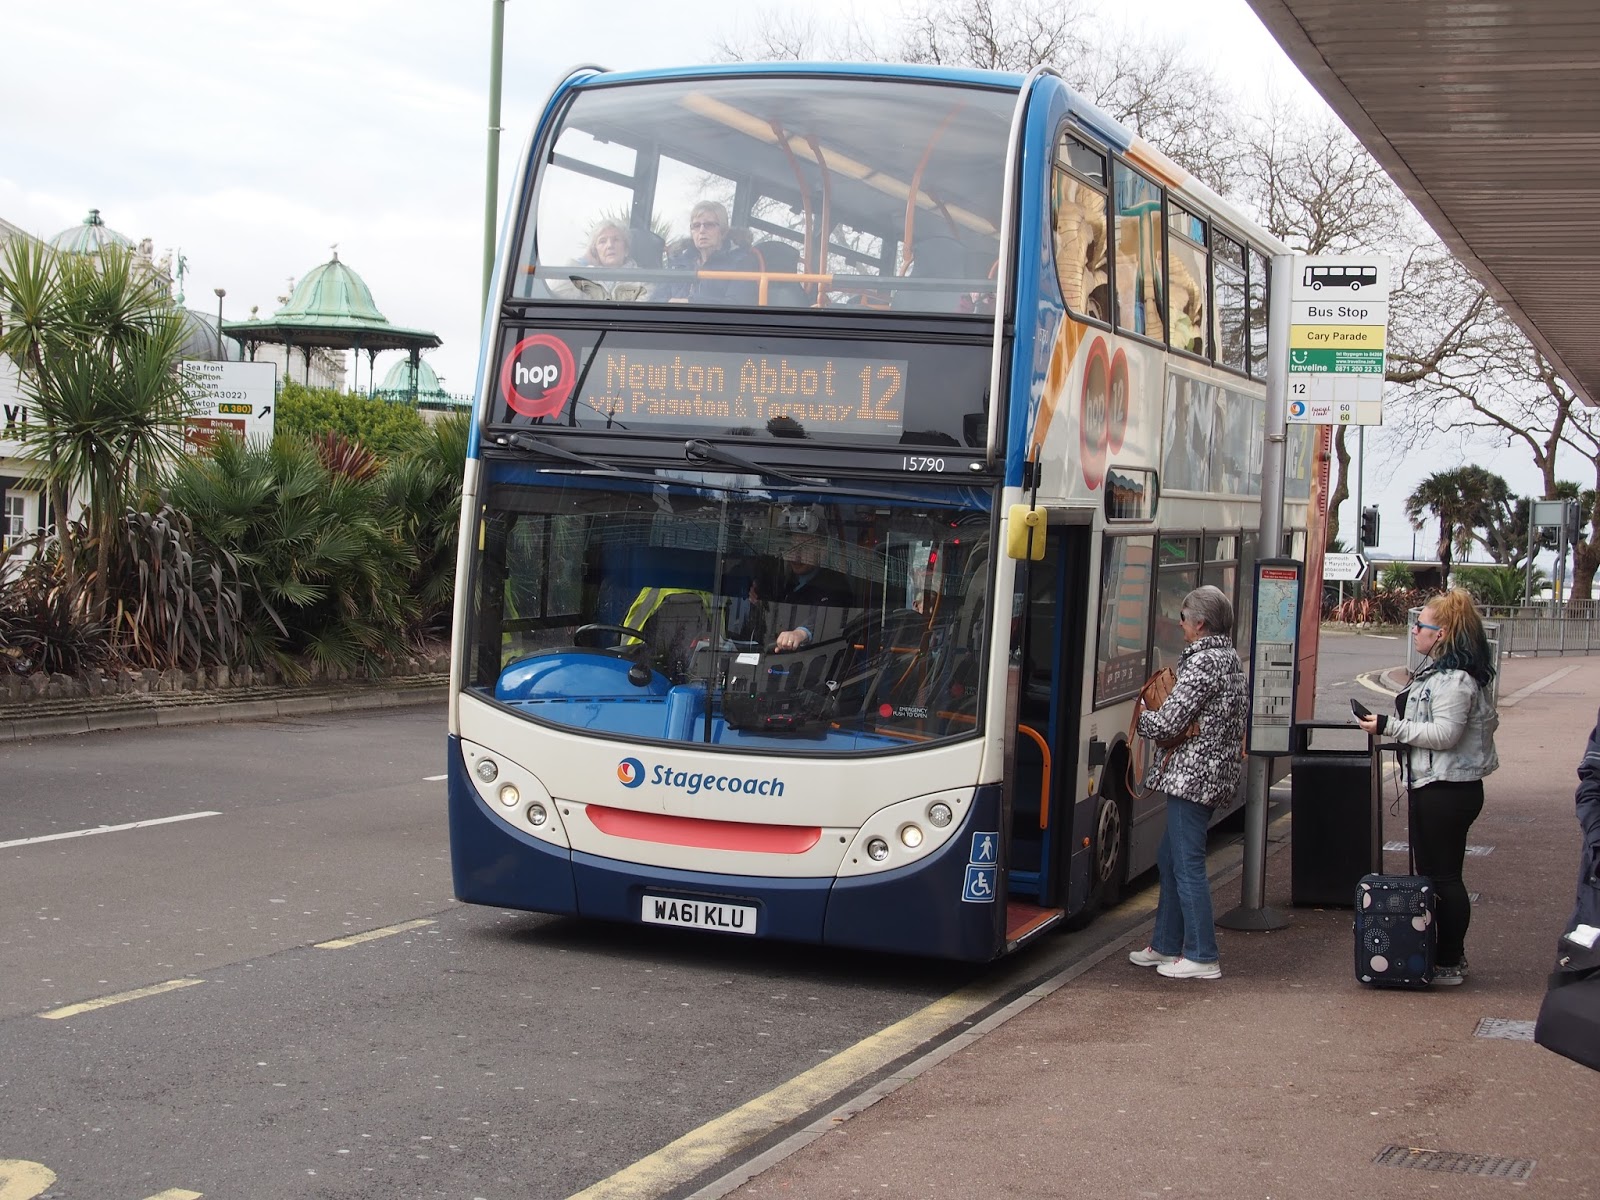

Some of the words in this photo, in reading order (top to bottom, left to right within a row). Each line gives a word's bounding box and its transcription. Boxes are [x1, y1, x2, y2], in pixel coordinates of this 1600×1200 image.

[1308, 306, 1333, 317] Bus
[1338, 306, 1368, 320] Stop
[1307, 331, 1330, 342] Cary
[1333, 332, 1368, 341] Parade
[186, 363, 201, 371] Sea
[203, 364, 224, 372] front
[1291, 363, 1328, 372] traveline
[515, 361, 558, 389] hop
[606, 354, 724, 392] Newton
[739, 358, 836, 396] Abbot
[186, 381, 219, 389] Briham
[1292, 383, 1306, 394] 12
[209, 391, 247, 399] (A3022)
[856, 365, 901, 420] 12
[230, 404, 252, 413] 380)
[589, 390, 625, 413] via
[631, 391, 729, 417] Paignton
[735, 395, 747, 418] &
[753, 396, 853, 421] Torquay
[1112, 379, 1124, 424] 12
[1340, 403, 1350, 411] 60
[1086, 388, 1105, 432] hop
[902, 456, 945, 473] 15790
[899, 706, 928, 714] EMERGENCY
[651, 764, 785, 797] Stagecoach
[655, 900, 699, 924] WA61
[704, 905, 744, 929] KLU
